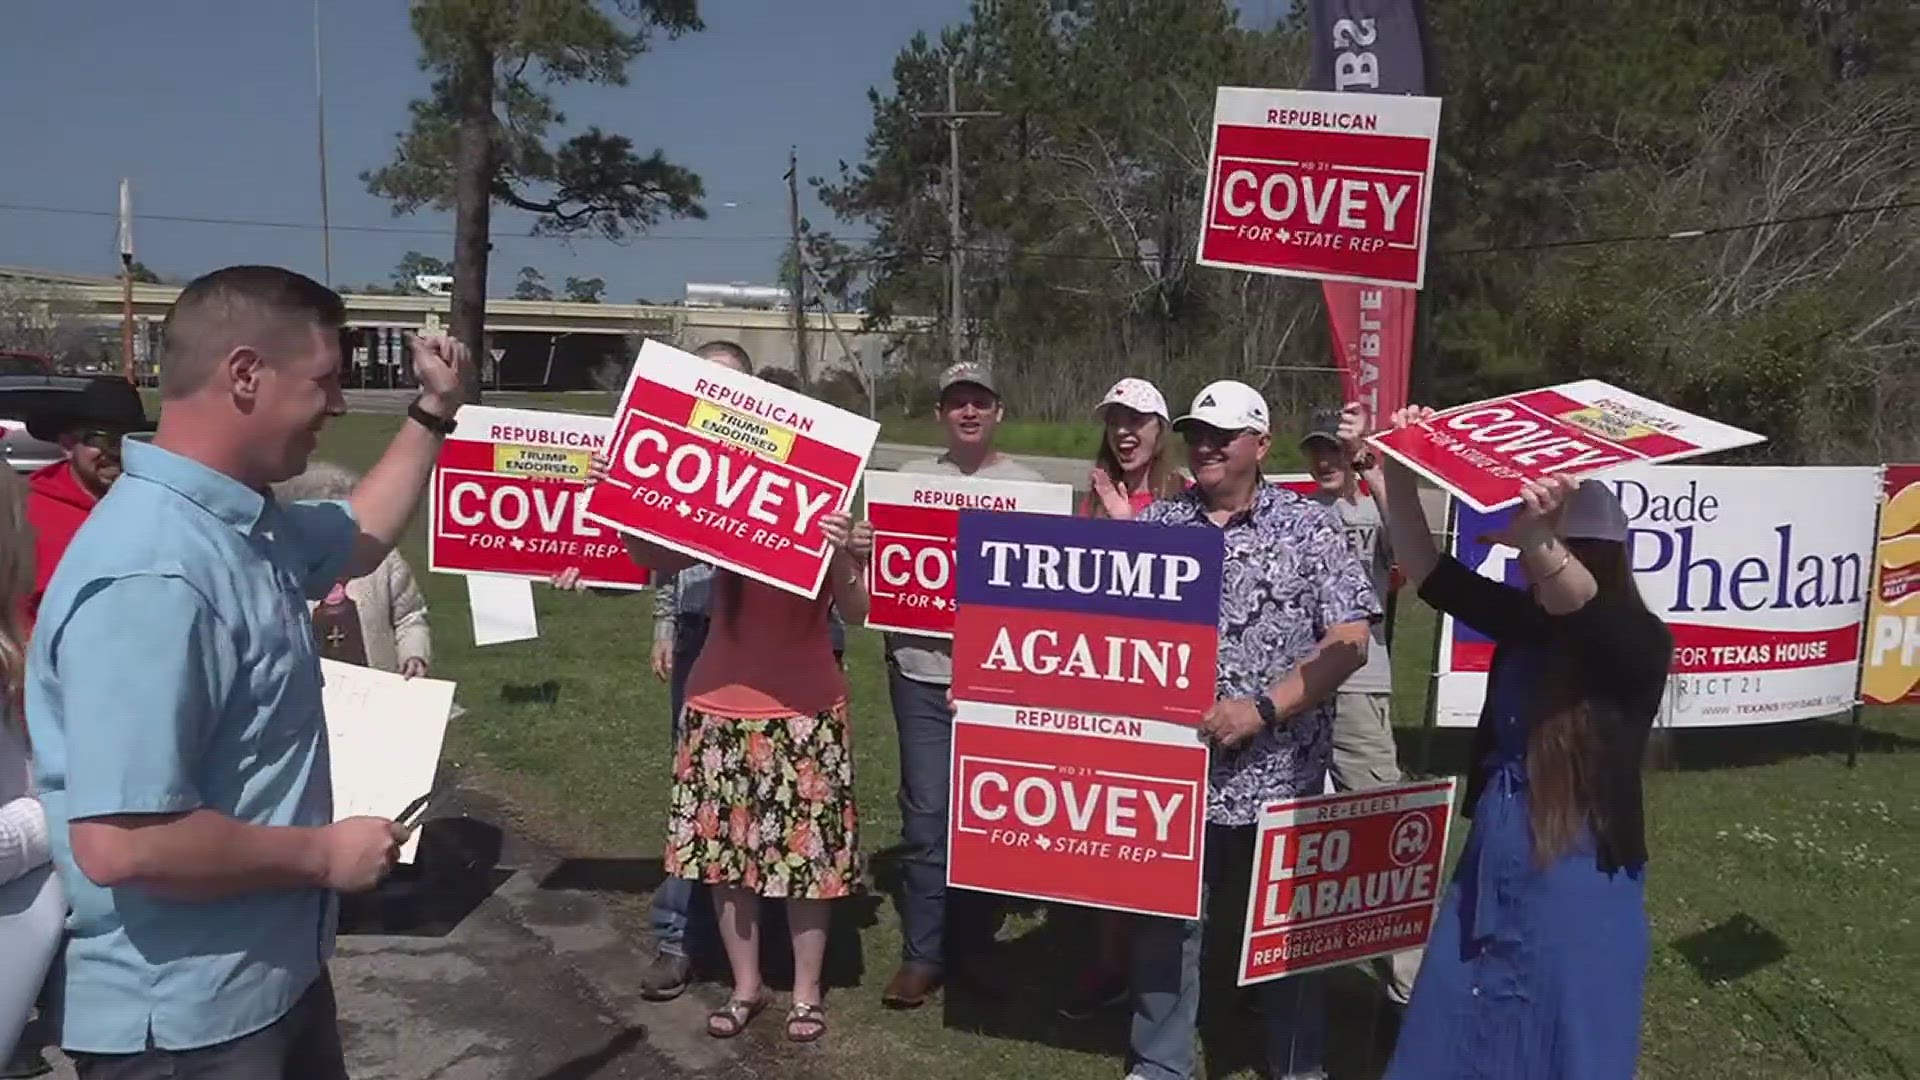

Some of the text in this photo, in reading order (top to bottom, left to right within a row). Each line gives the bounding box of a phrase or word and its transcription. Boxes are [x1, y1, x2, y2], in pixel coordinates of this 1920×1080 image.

[1267, 109, 1378, 130] REPUBLICAN
[1222, 169, 1411, 232] COVEY
[1237, 225, 1385, 253] FOR STATE REP
[695, 379, 815, 433] REPUBLICAN
[720, 413, 769, 437] TRUMP
[490, 425, 606, 448] REPUBLICAN
[701, 419, 778, 453] ENDORSED
[1447, 408, 1621, 474] COVEY
[505, 460, 579, 474] ENDORSED
[519, 450, 567, 462] TRUMP
[623, 428, 833, 536] COVEY
[913, 490, 1016, 511] REPUBLICAN
[1612, 479, 1719, 522] Dade
[449, 481, 601, 537] COVE
[631, 486, 791, 552] FOR STATE REP
[469, 533, 619, 558] FOR STATE REP
[880, 543, 957, 590] CO
[980, 541, 1201, 601] TRUMP
[1627, 524, 1863, 612] Phelan
[897, 592, 930, 608] FOR
[980, 626, 1192, 689] AGAIN!
[1710, 643, 1770, 665] TEXAS
[1775, 641, 1828, 663] HOUSE
[1740, 677, 1761, 693] 21
[1015, 709, 1143, 737] REPUBLICAN
[969, 771, 1184, 842] COVEY
[1317, 795, 1402, 820] RE-ELECT
[990, 829, 1158, 863] FOR STATE REP
[1268, 829, 1351, 882] LEO
[1263, 863, 1434, 927] LABAUVE
[1253, 920, 1424, 967] REPUBLICAN CHAIRMAN
